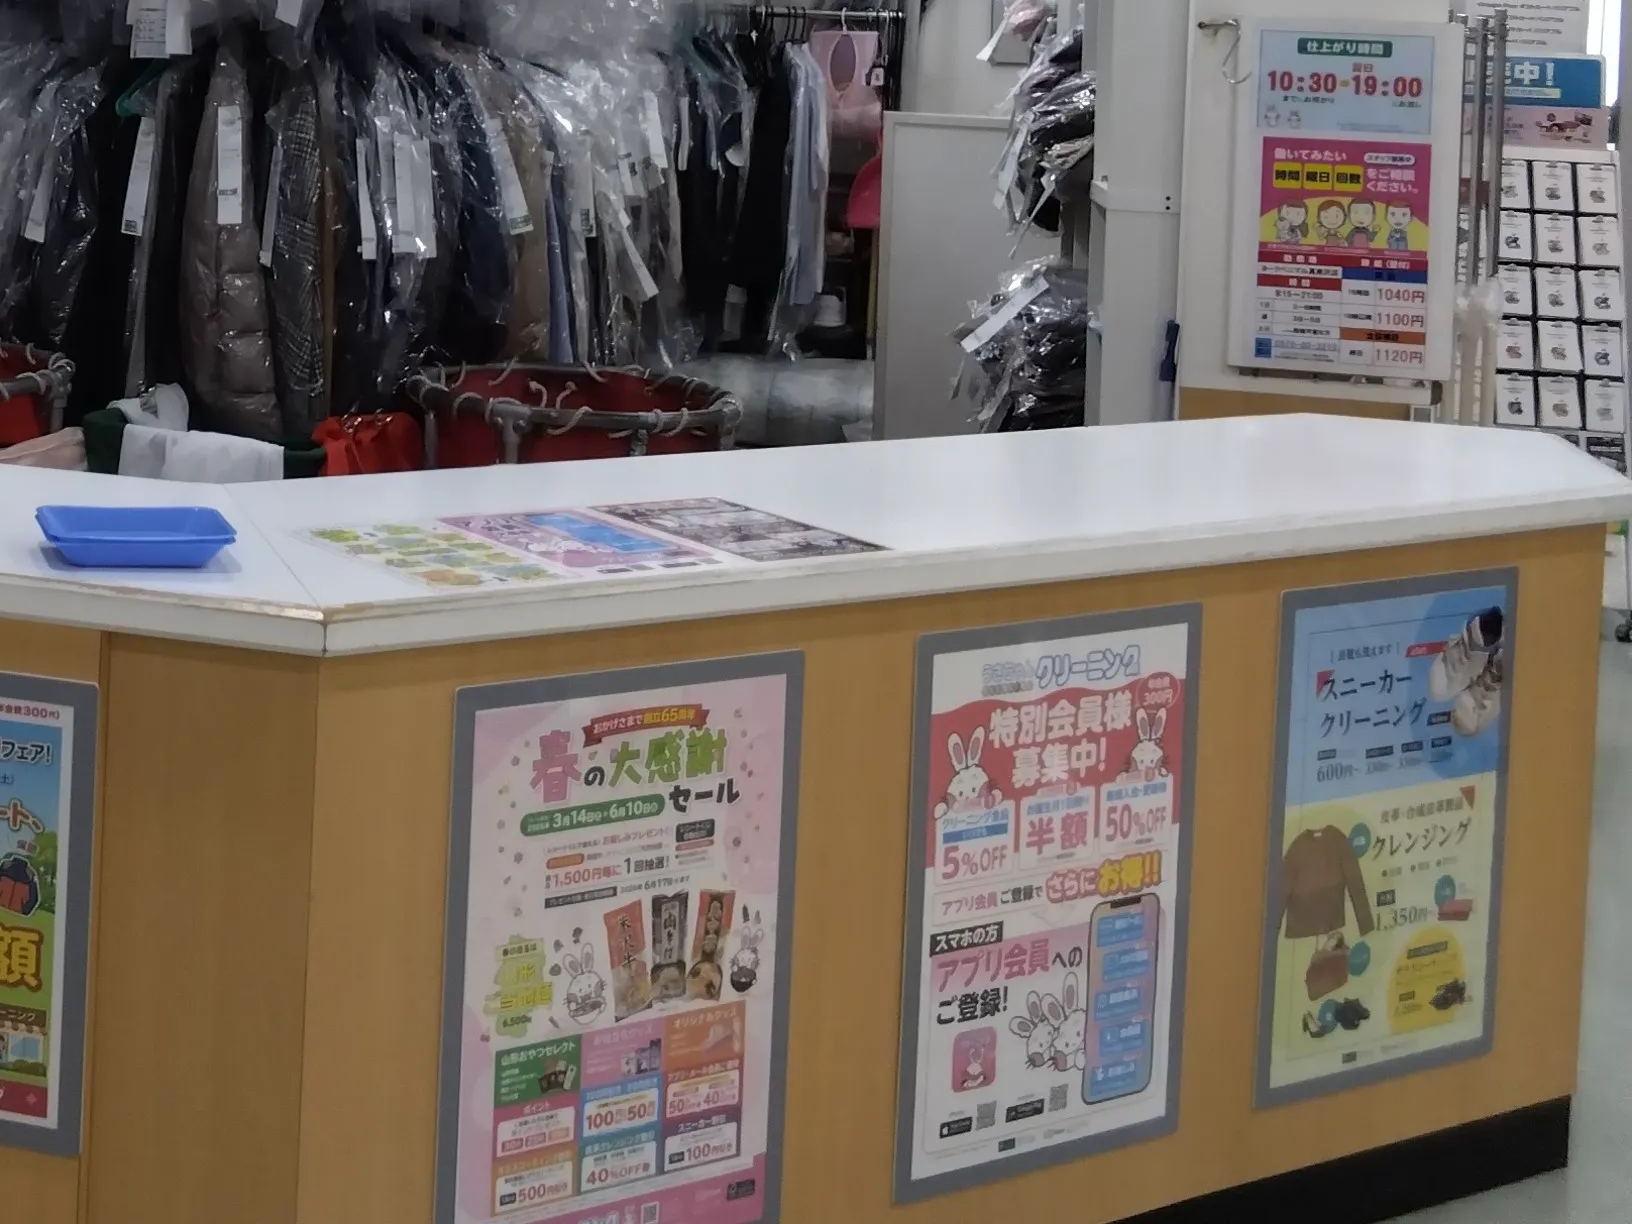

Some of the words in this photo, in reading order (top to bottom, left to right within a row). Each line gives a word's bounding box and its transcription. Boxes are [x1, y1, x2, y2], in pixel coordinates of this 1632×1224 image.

[1307, 41, 1384, 55] 仕上がり時間
[1268, 70, 1338, 94] 10:30
[1351, 75, 1422, 98] 19:00
[1274, 169, 1300, 182] 時間
[1336, 172, 1361, 184] 回数
[1366, 180, 1418, 194] ください。
[1377, 287, 1425, 304] 1040円
[1377, 312, 1424, 328] 1100円
[1375, 349, 1423, 365] 1120円
[1035, 644, 1141, 689] クリーニング
[1323, 669, 1412, 701] スニーカー
[988, 689, 1132, 749] 特別会員様
[1320, 697, 1427, 738] クリーニング
[529, 727, 728, 804] 春の大感謝
[1011, 736, 1107, 789] 募集中!
[669, 778, 741, 814] セール
[1025, 811, 1089, 857] 半額
[1106, 803, 1167, 842] 50%OFF
[1372, 816, 1472, 861] クレンジング
[942, 844, 1008, 880] 5%OFF
[935, 925, 999, 952] スマホの方
[937, 939, 1082, 993] アプリ会員への
[936, 986, 1009, 1025] ご登録!
